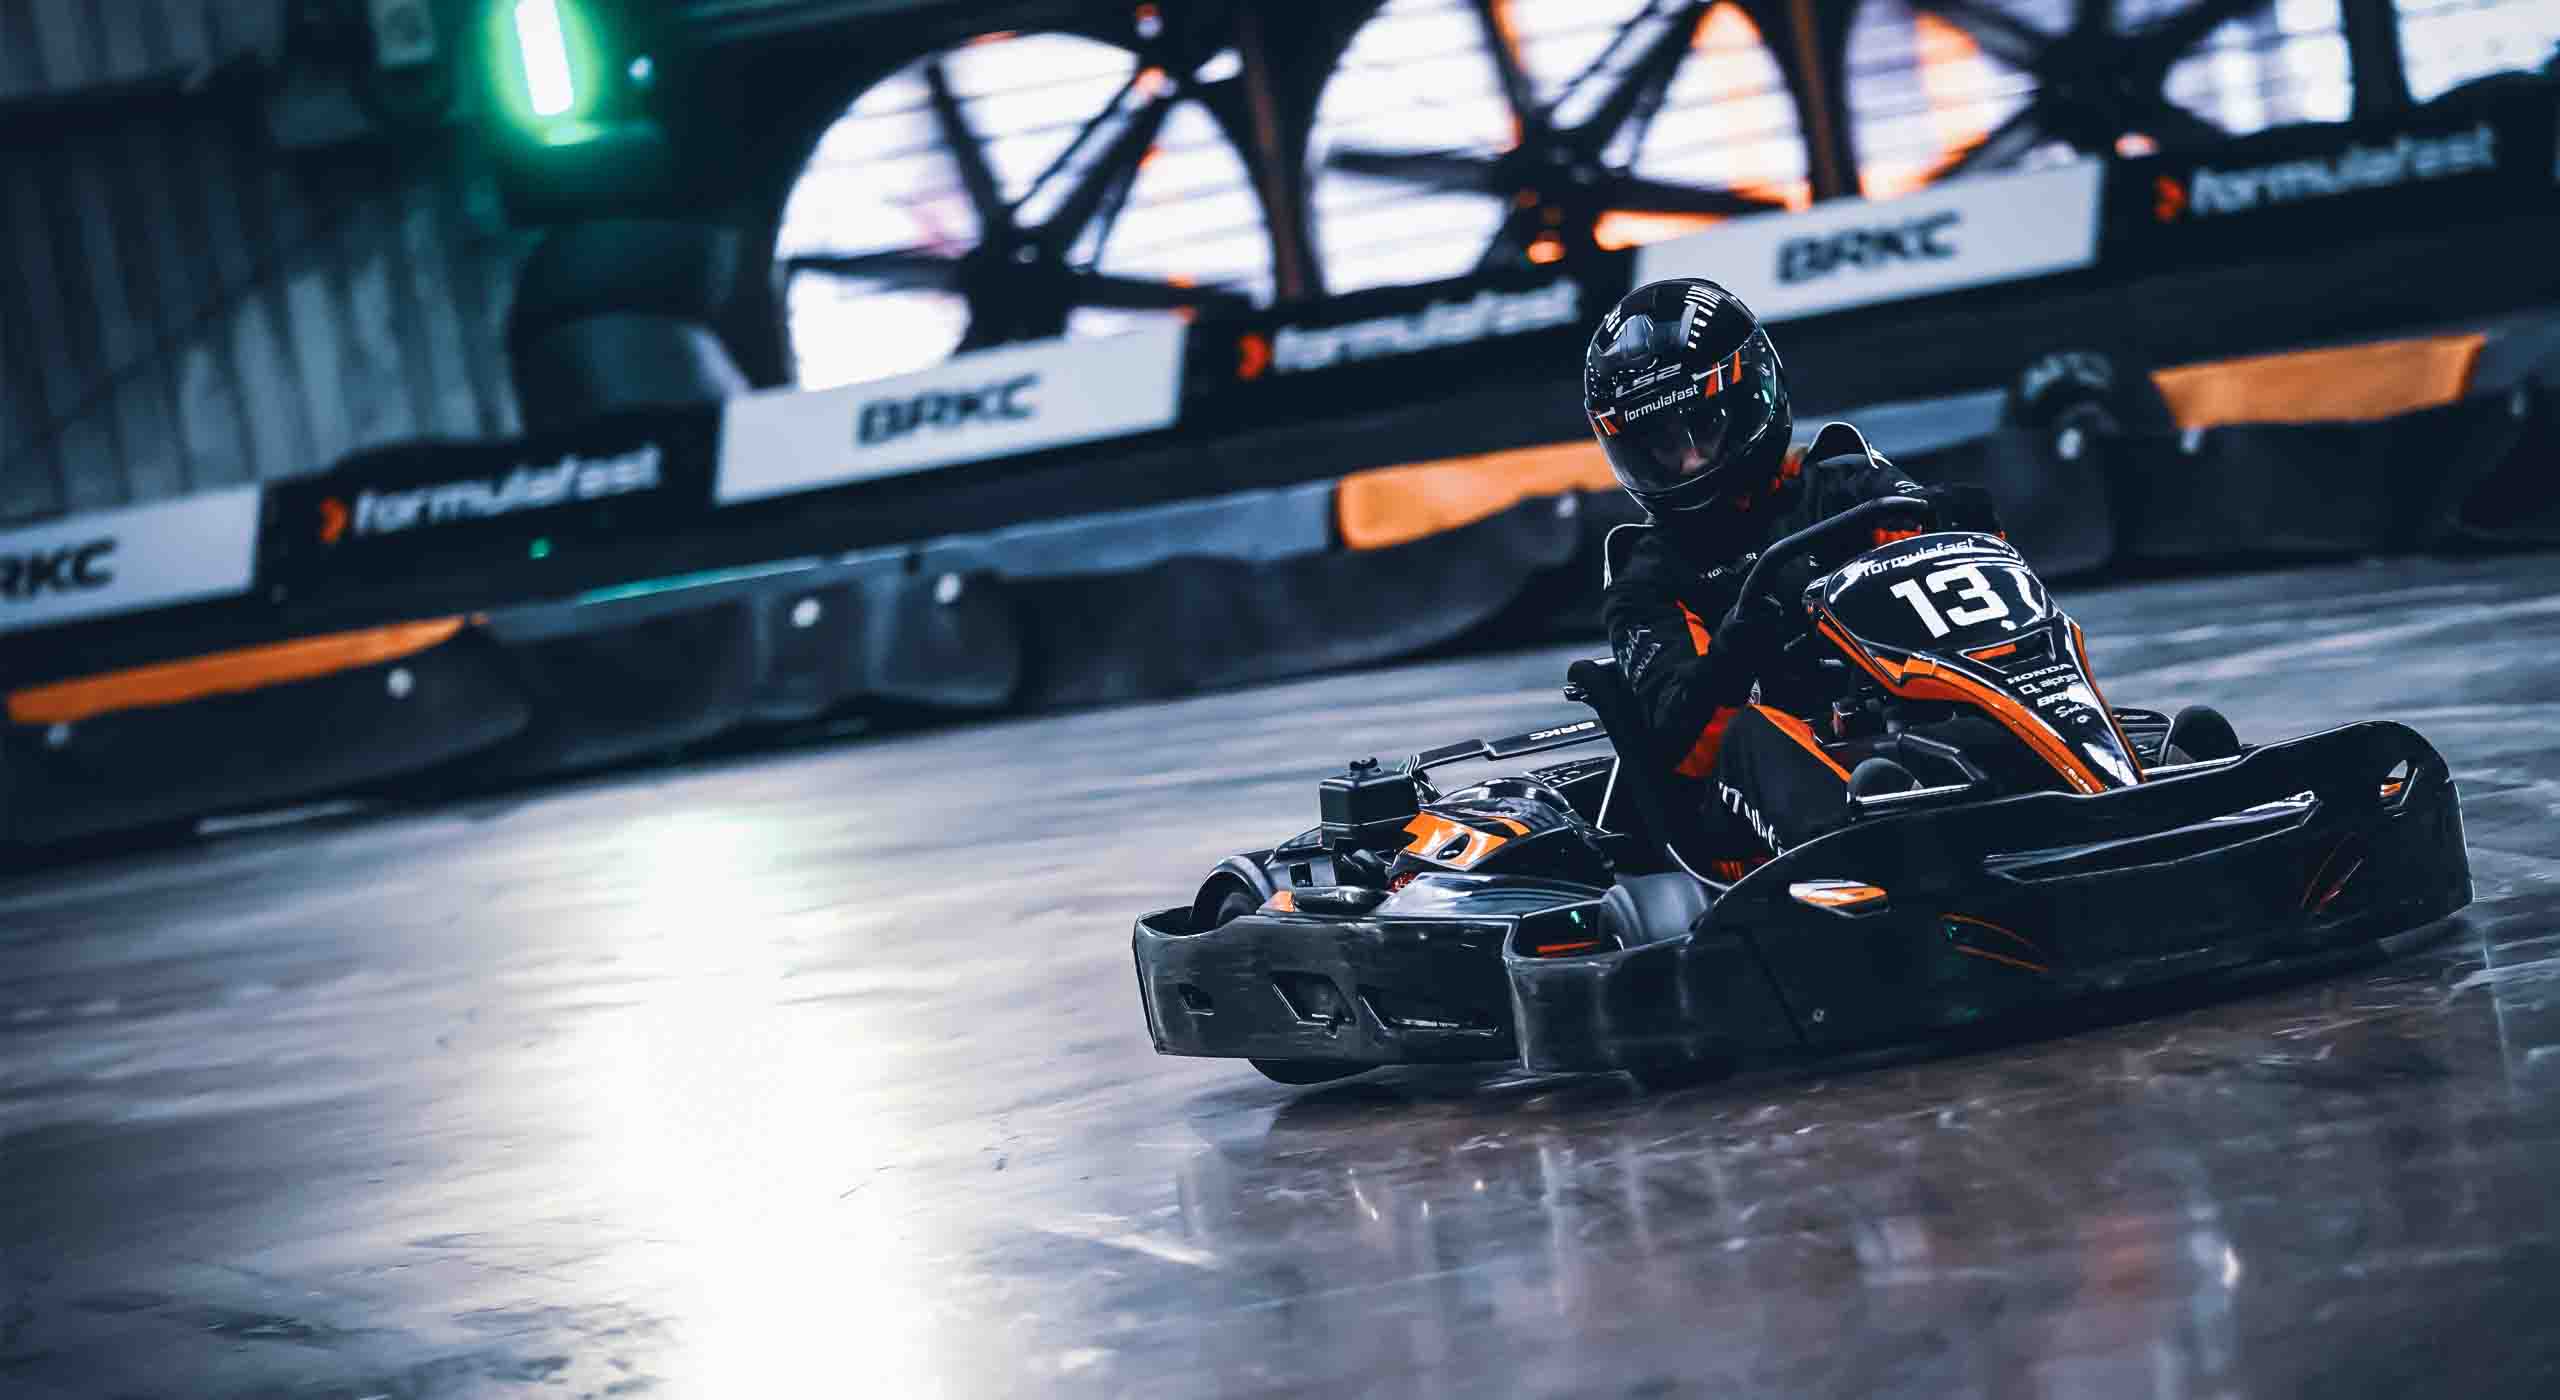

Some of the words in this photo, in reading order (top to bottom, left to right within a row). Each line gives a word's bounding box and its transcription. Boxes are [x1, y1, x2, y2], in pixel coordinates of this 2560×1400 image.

[2190, 123, 2494, 216] formulafast
[1778, 211, 1959, 284] BRKC
[1273, 277, 1581, 372] formulafast
[1615, 363, 1682, 399] LS2
[1624, 383, 1699, 423] formulafast
[857, 373, 1041, 446] BRKC
[355, 443, 663, 536] formulafast
[1861, 537, 1975, 577] formulafast
[1889, 563, 2010, 640] 13
[2005, 663, 2074, 685] HONDA
[2040, 673, 2079, 688] alpha
[1528, 721, 1596, 741] BRKC
